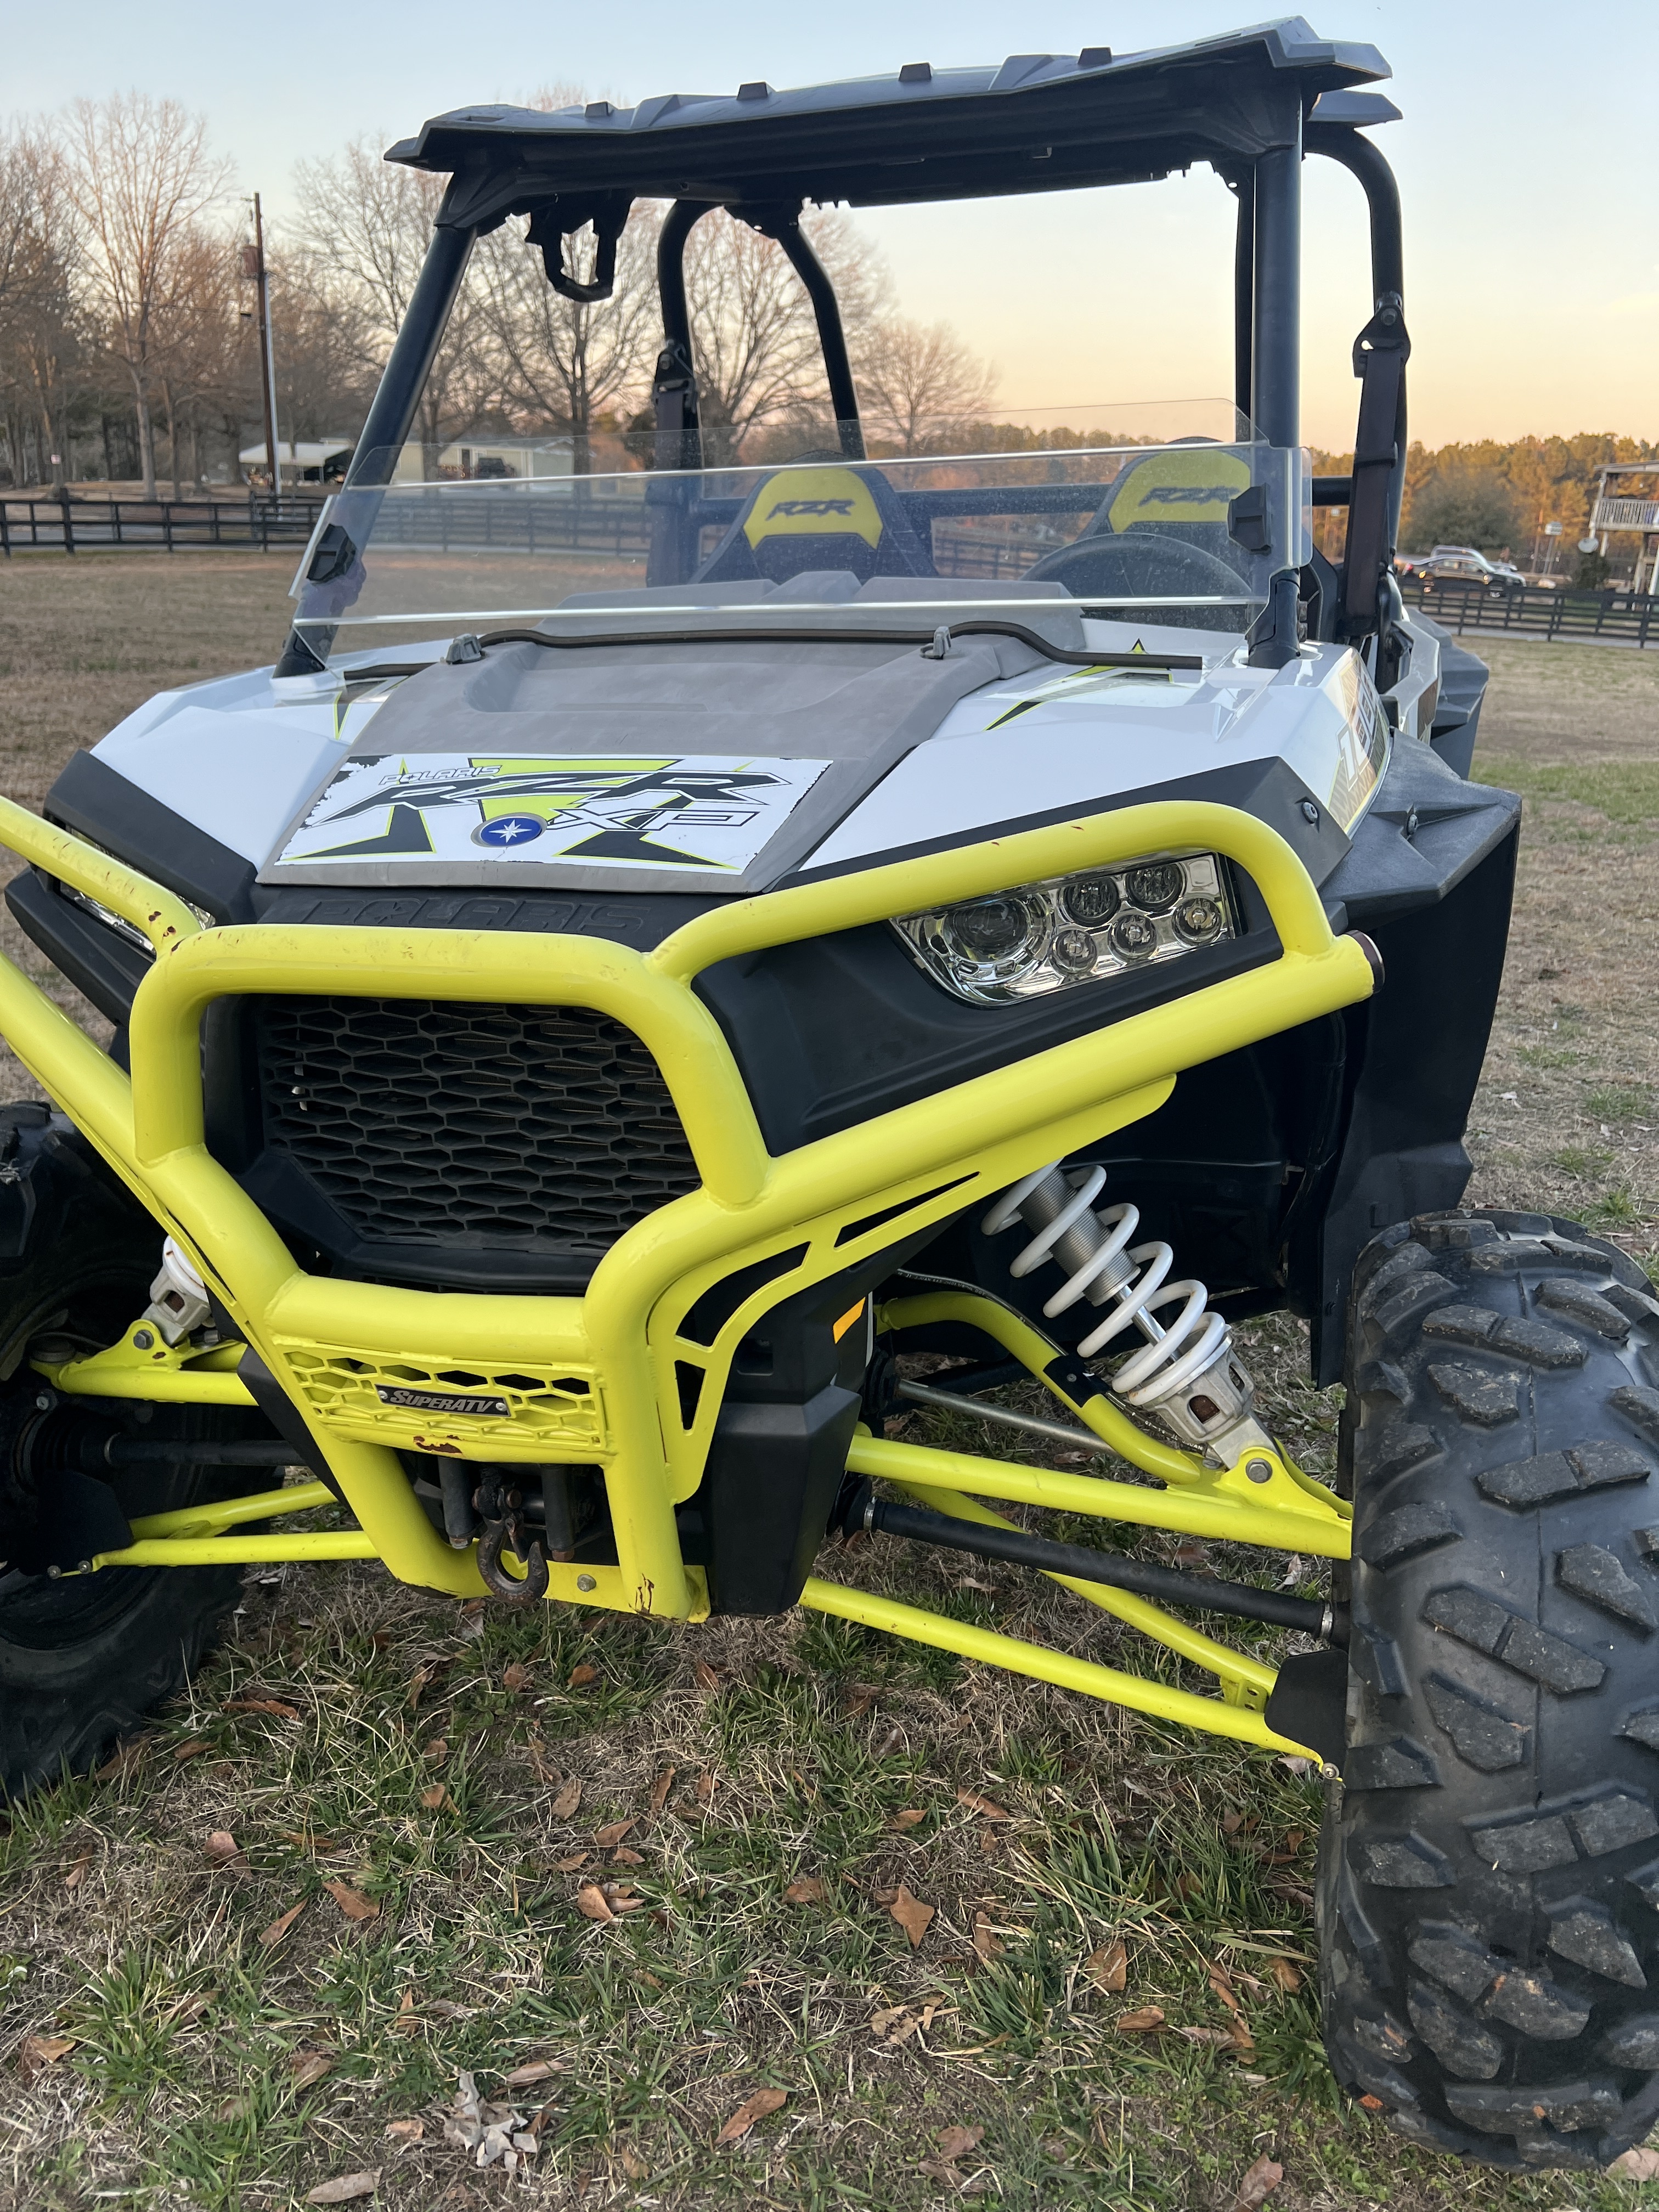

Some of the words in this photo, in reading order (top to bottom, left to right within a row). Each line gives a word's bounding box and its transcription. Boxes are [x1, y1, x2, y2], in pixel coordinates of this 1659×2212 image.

[1138, 486, 1239, 507] RZR
[765, 498, 855, 521] RZR
[379, 765, 503, 786] POLARIS
[307, 770, 792, 830] RZR
[547, 808, 761, 831] XP
[301, 897, 652, 932] POLARIS
[390, 1390, 494, 1413] SUPERATV
